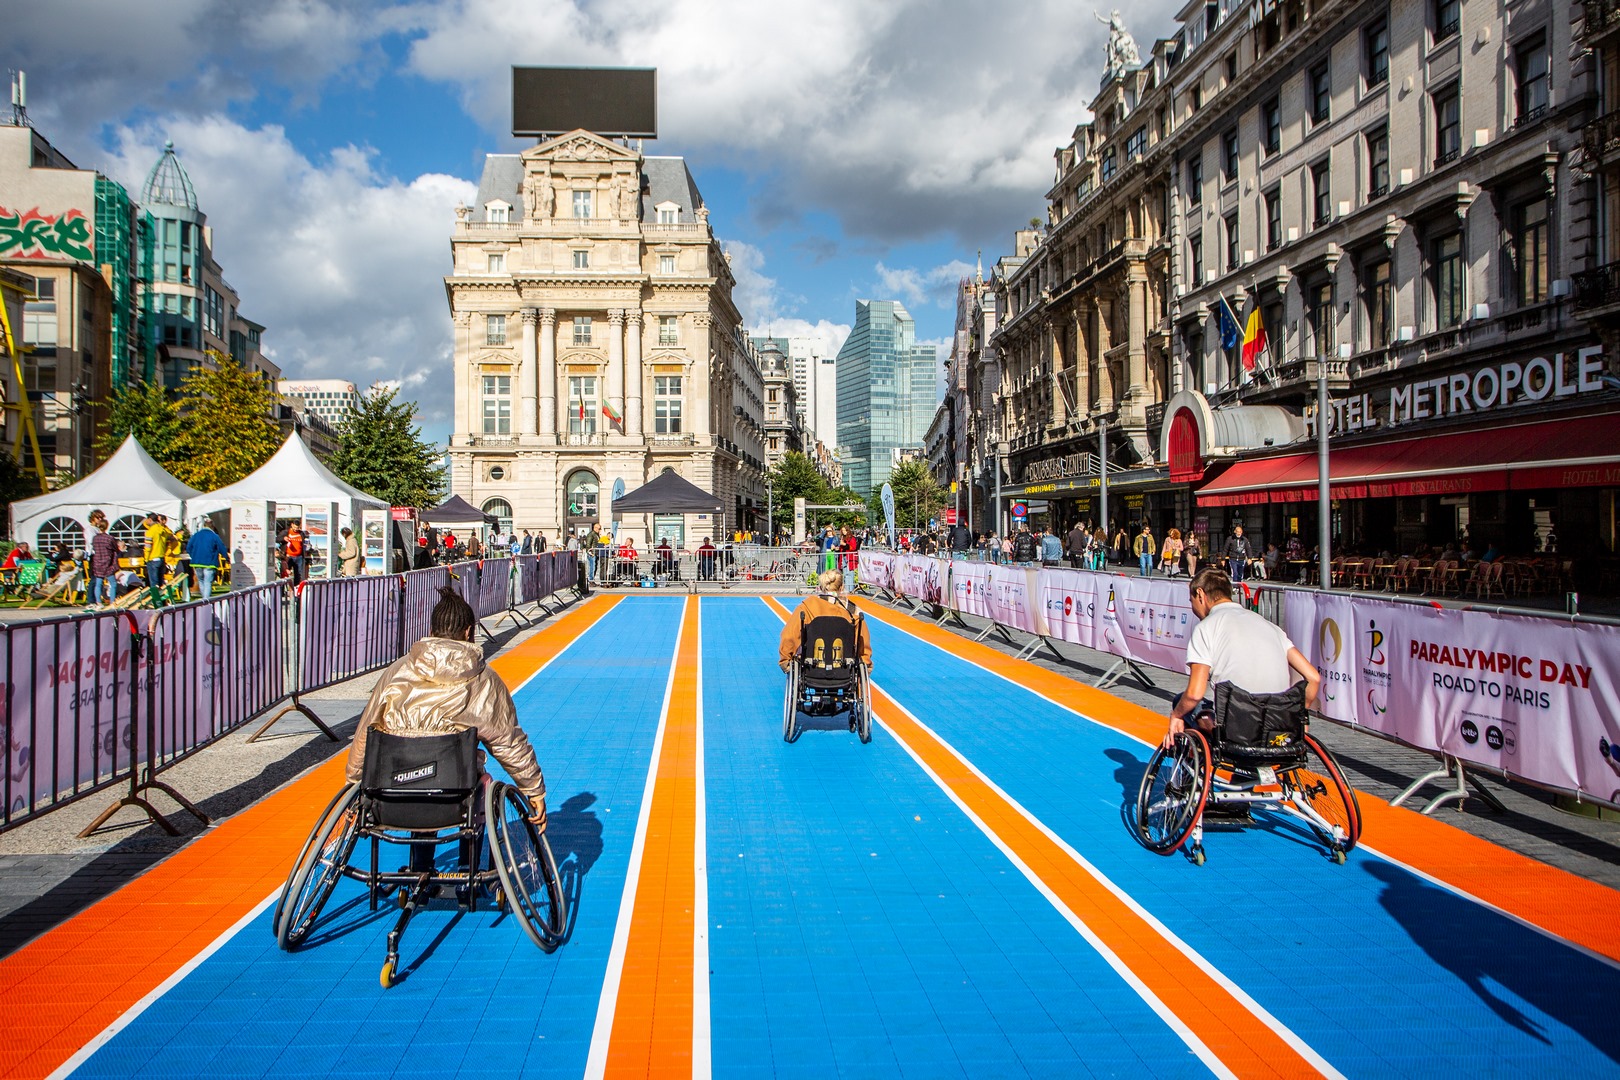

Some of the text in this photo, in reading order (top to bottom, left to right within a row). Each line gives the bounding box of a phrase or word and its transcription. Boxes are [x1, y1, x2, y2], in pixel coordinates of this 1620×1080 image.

[1389, 345, 1603, 422] METROPOLE
[1173, 452, 1199, 469] HOTEL
[1562, 470, 1601, 484] HOTEL
[1373, 485, 1388, 497] BAR
[1411, 478, 1471, 494] RESTAURANTS
[1411, 639, 1592, 689] PARALYMPIC DAY
[1330, 670, 1352, 682] 2024
[1363, 667, 1391, 680] PARALYMPIC
[1433, 672, 1550, 709] ROAD TO PARIS
[1488, 736, 1501, 745] BXL
[397, 766, 434, 782] QUICKIE
